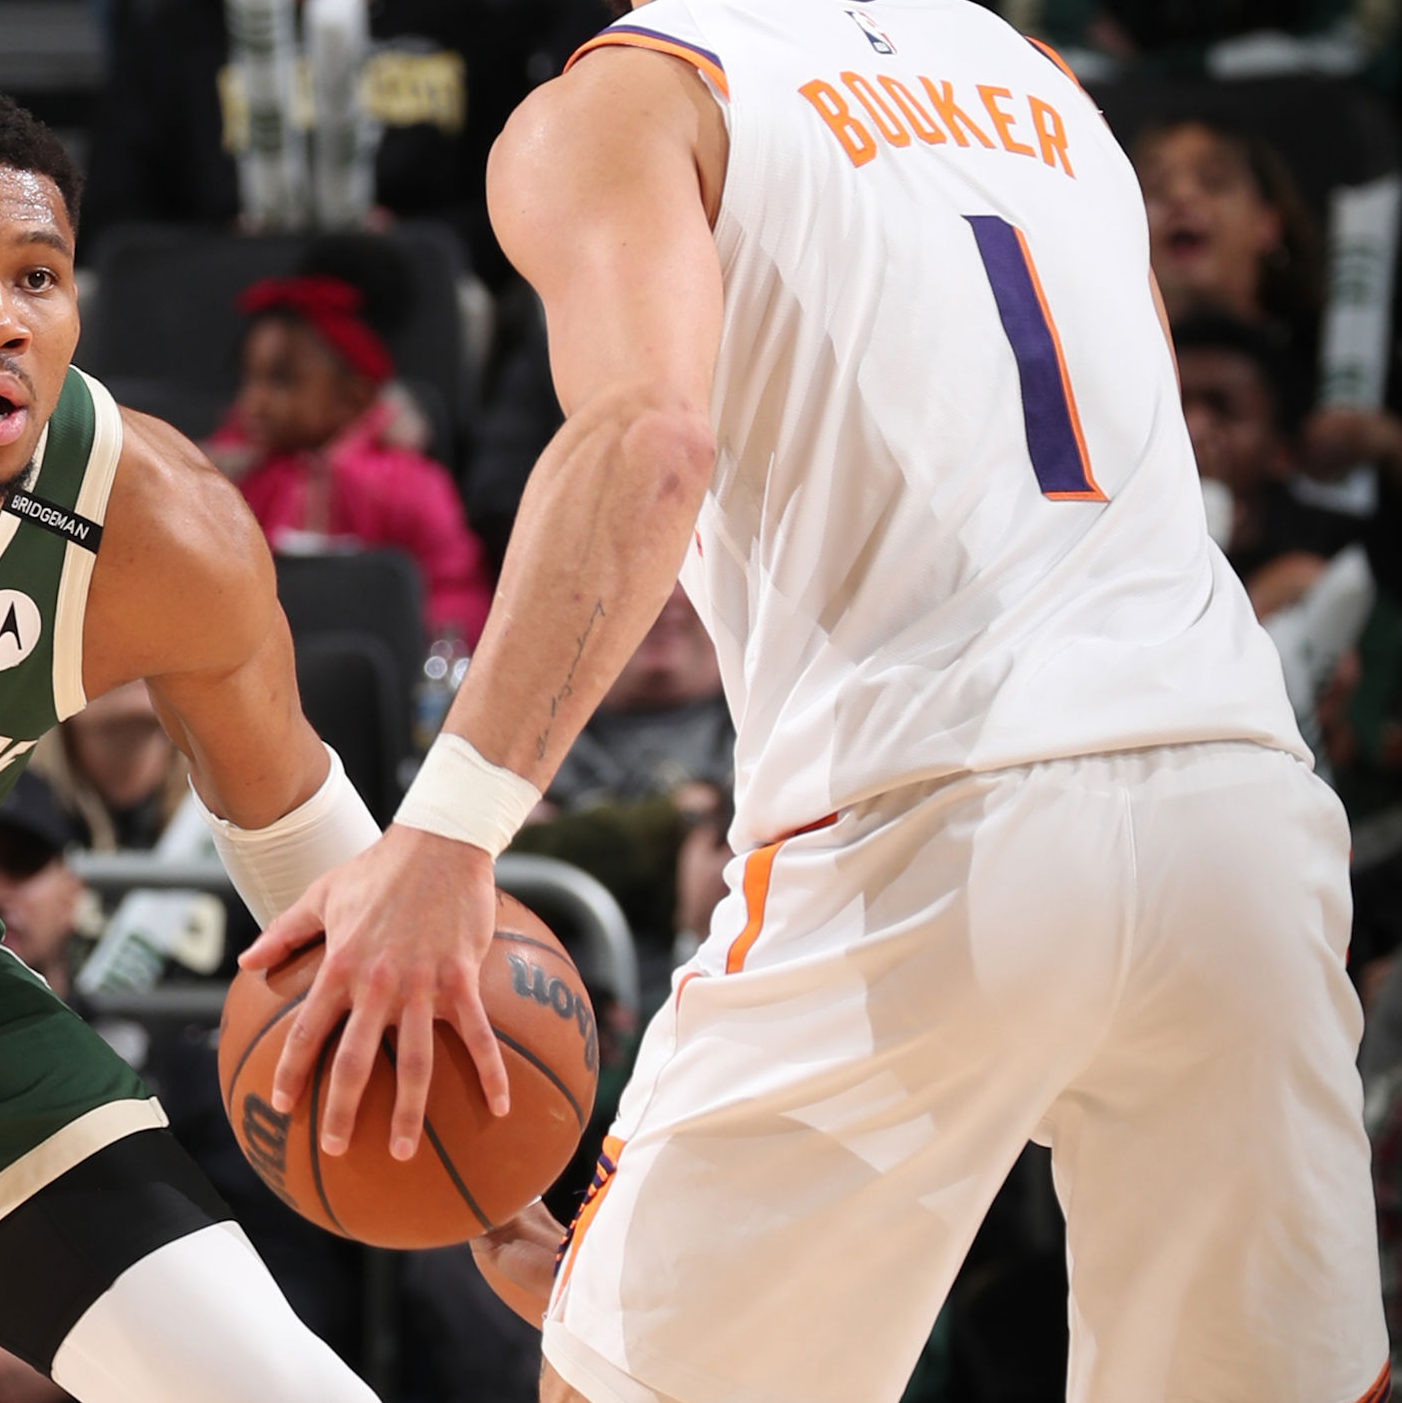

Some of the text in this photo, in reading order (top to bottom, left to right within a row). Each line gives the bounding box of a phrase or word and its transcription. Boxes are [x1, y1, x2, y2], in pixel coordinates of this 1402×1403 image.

[798, 71, 1076, 179] BOOKER
[961, 215, 1111, 502] 1
[11, 495, 90, 540] BRIDGEMAN
